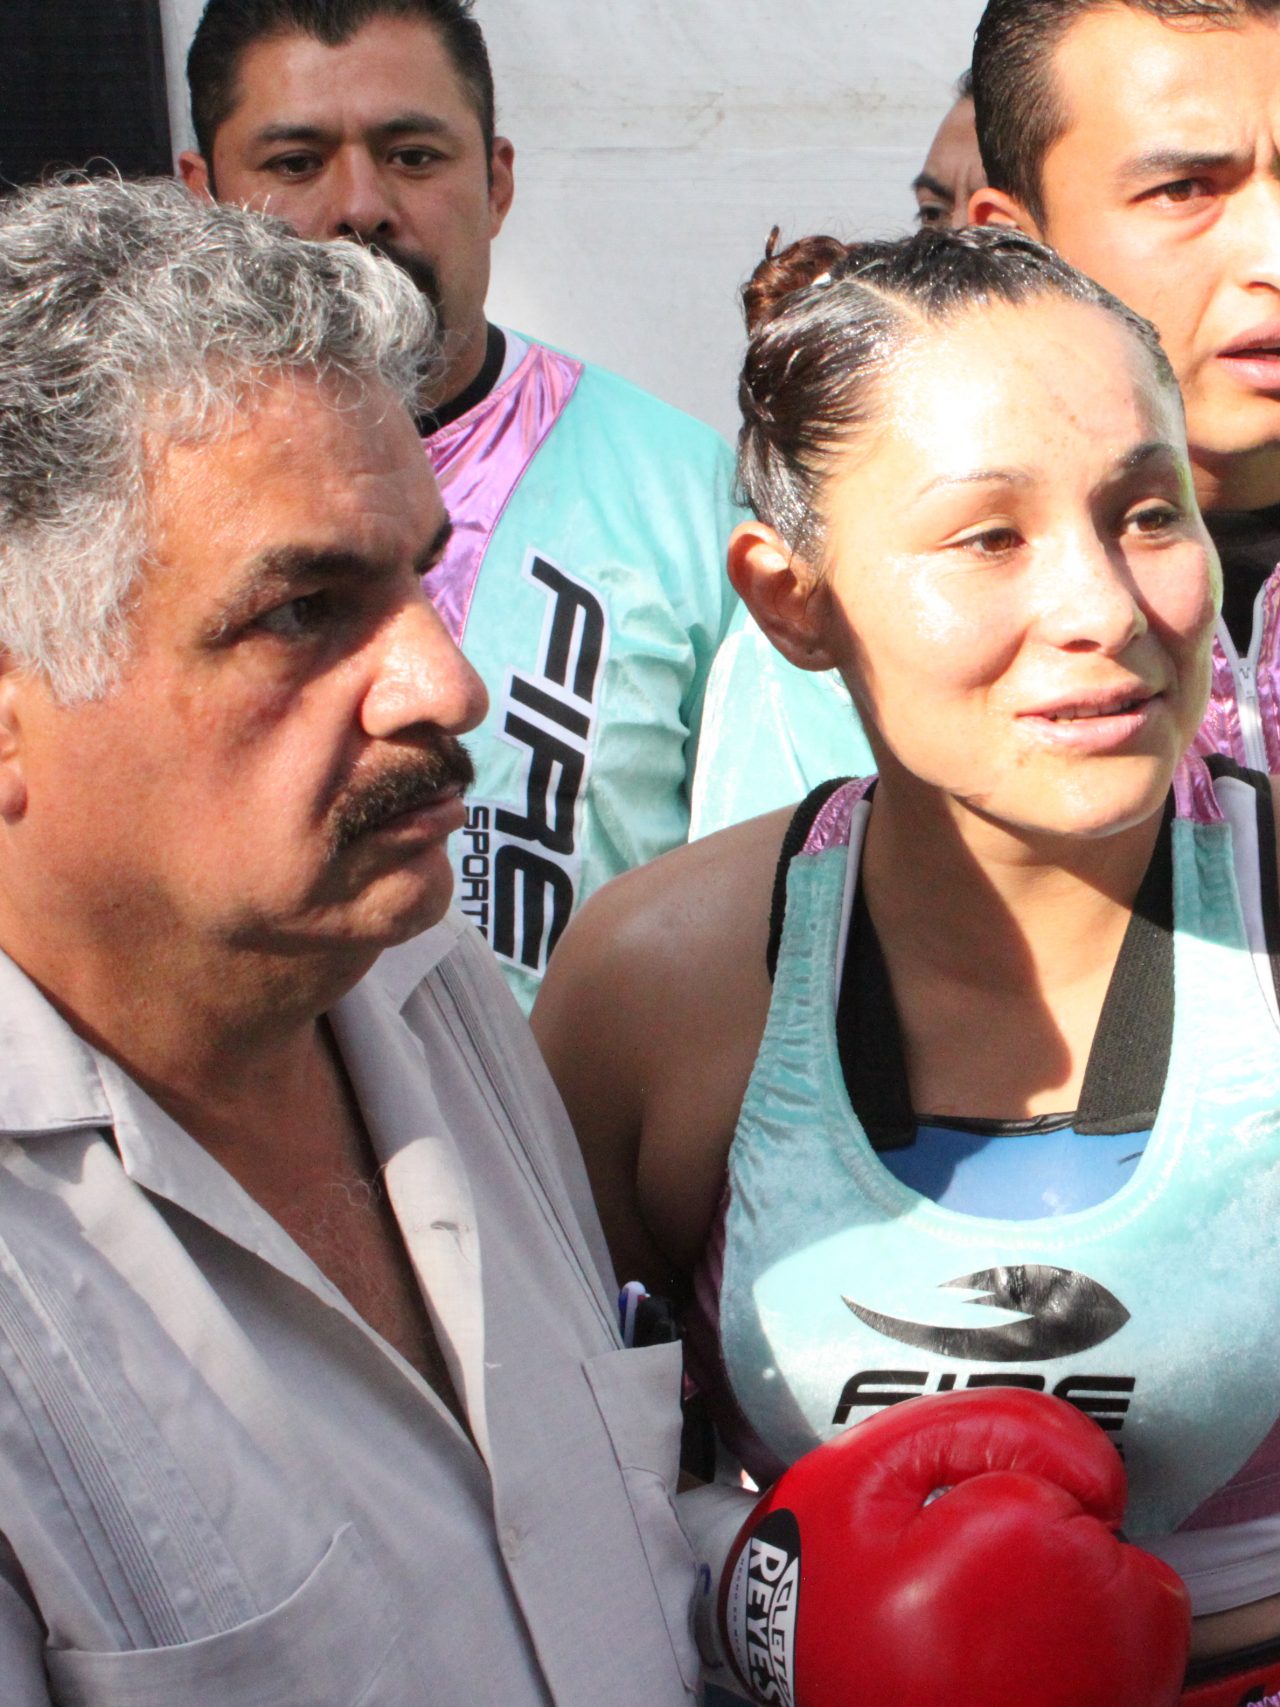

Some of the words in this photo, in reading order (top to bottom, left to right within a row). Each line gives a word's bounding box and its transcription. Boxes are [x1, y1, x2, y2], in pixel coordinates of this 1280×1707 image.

[493, 556, 605, 970] FIRE
[831, 1369, 1136, 1432] FE
[748, 1537, 789, 1707] REYES
